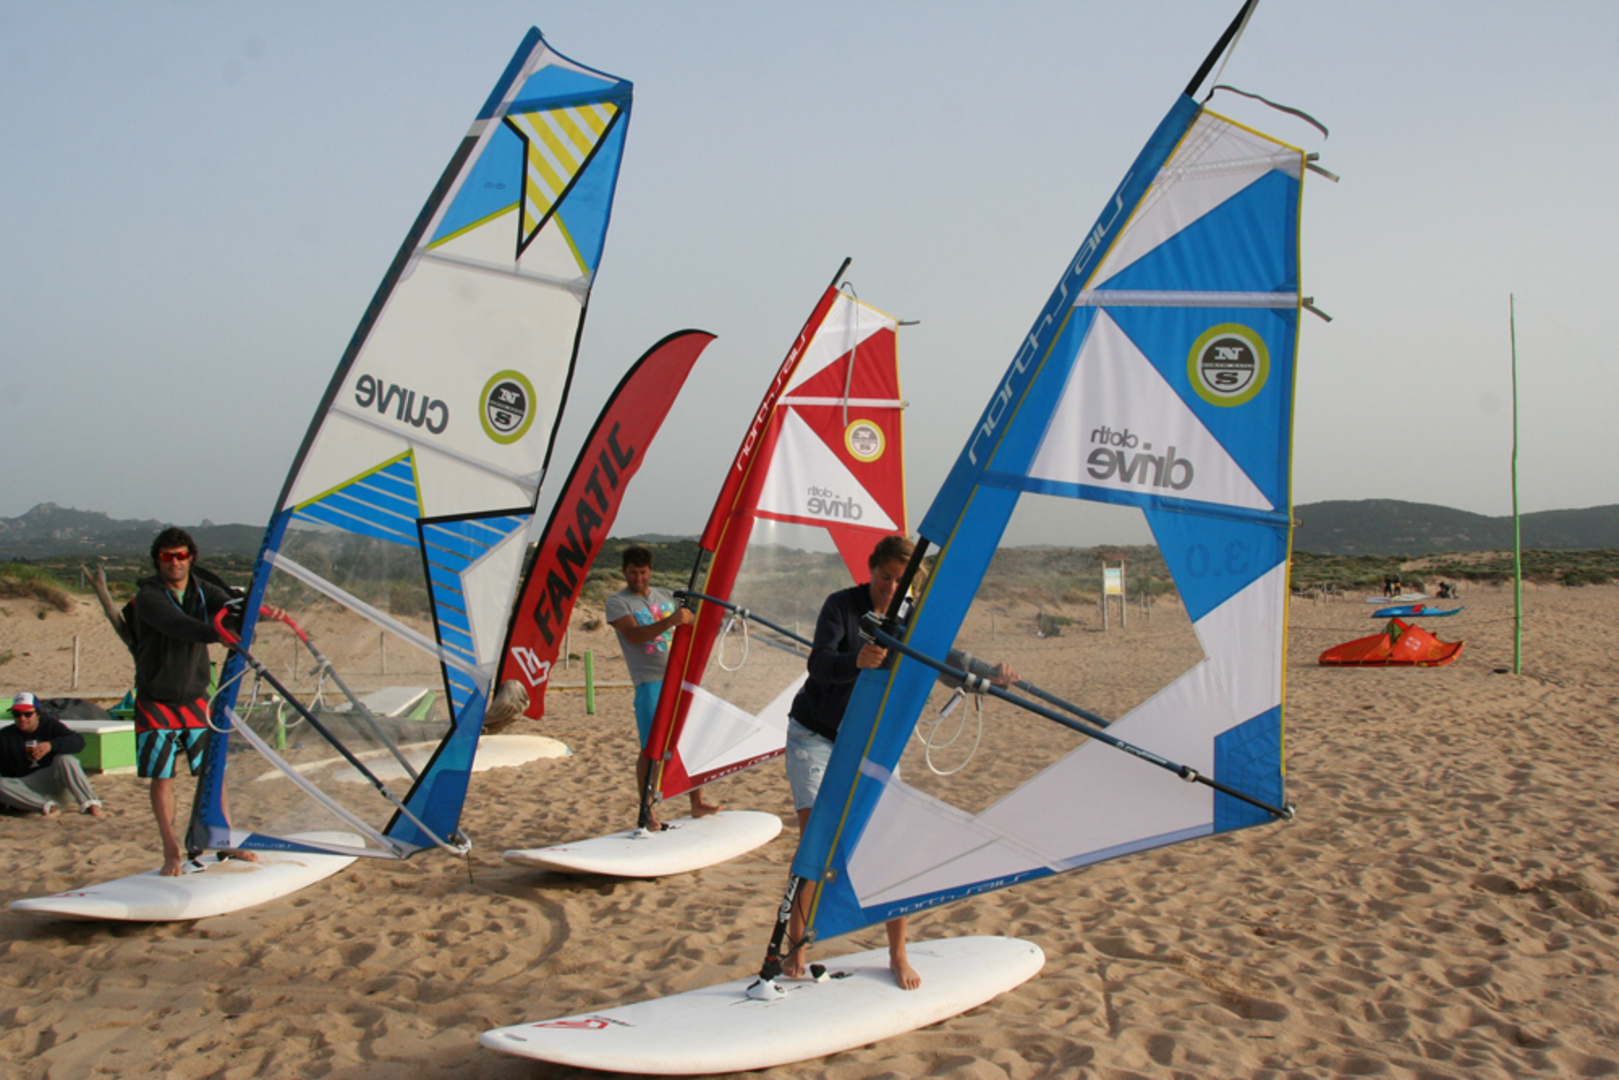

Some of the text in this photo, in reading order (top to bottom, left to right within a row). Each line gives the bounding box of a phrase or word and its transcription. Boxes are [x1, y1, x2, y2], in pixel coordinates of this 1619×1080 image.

[968, 171, 1134, 466] north sails
[533, 420, 636, 648] FANATIC
